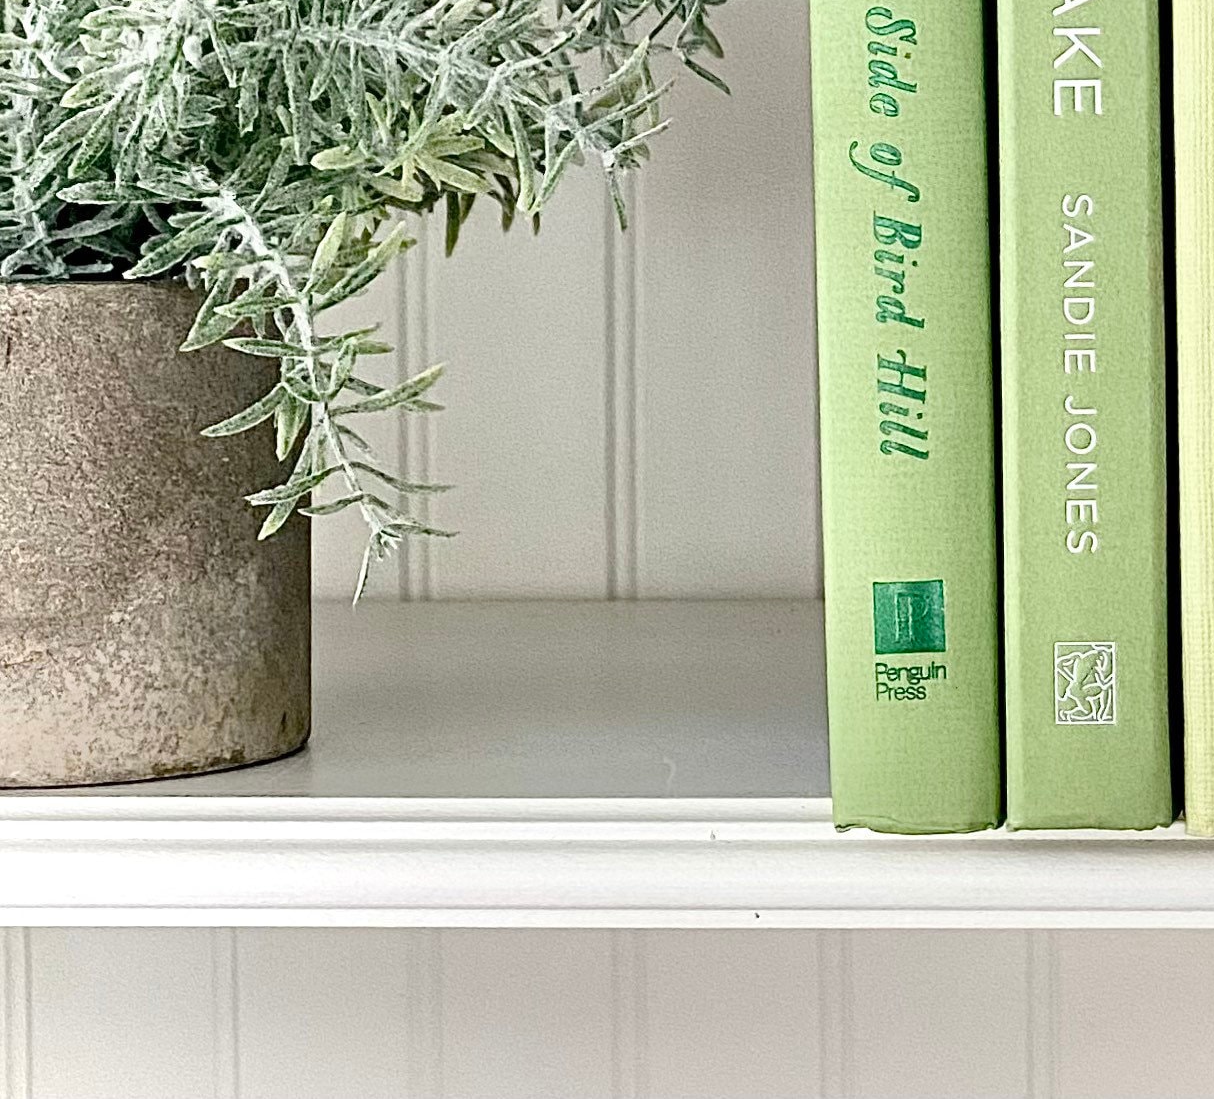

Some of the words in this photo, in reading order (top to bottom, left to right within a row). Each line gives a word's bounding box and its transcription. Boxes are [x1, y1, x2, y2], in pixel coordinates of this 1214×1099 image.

[864, 5, 918, 117] Side
[849, 141, 920, 202] of
[872, 210, 926, 332] Bird
[1061, 193, 1096, 373] SANDIE
[877, 350, 929, 462] Hill
[1063, 392, 1098, 556] JONES
[875, 662, 947, 683] Penguin
[875, 682, 927, 701] Press
